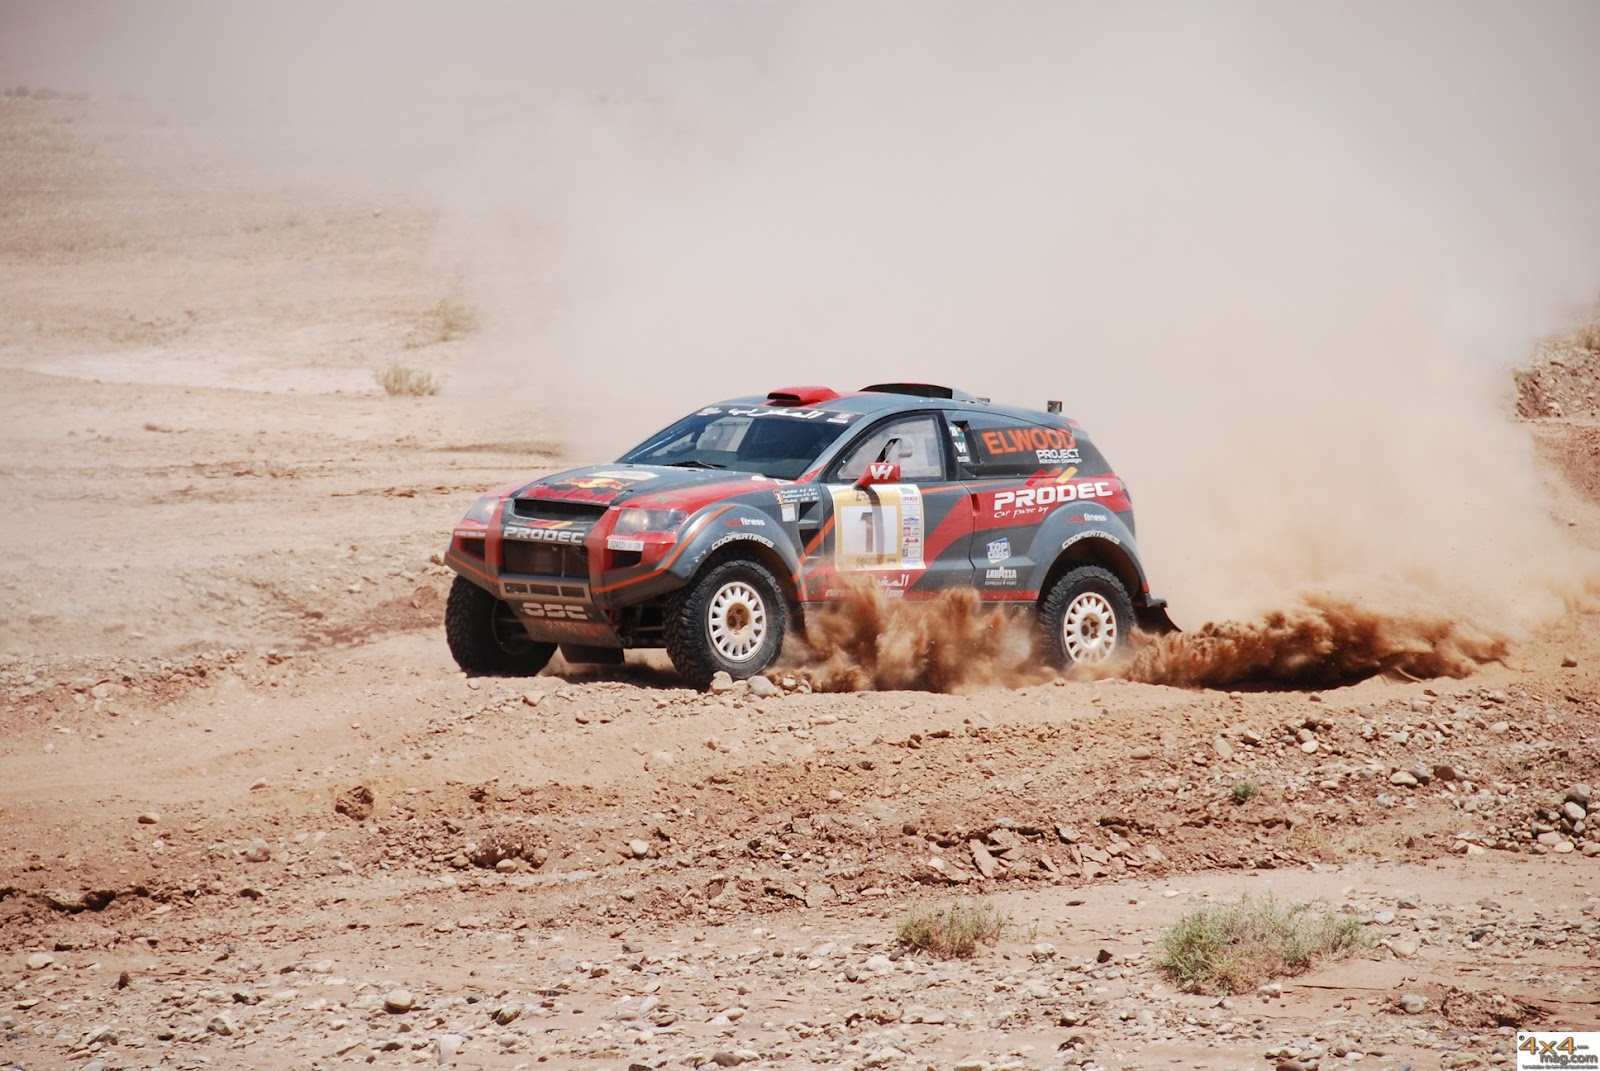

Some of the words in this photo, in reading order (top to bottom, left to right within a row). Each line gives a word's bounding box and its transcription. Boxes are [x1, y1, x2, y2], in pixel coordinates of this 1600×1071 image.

[981, 428, 1076, 455] ELWOOD
[1035, 448, 1080, 459] PROJECT
[993, 481, 1114, 511] PRODEC
[503, 526, 585, 544] PRODEC
[859, 512, 873, 553] 1
